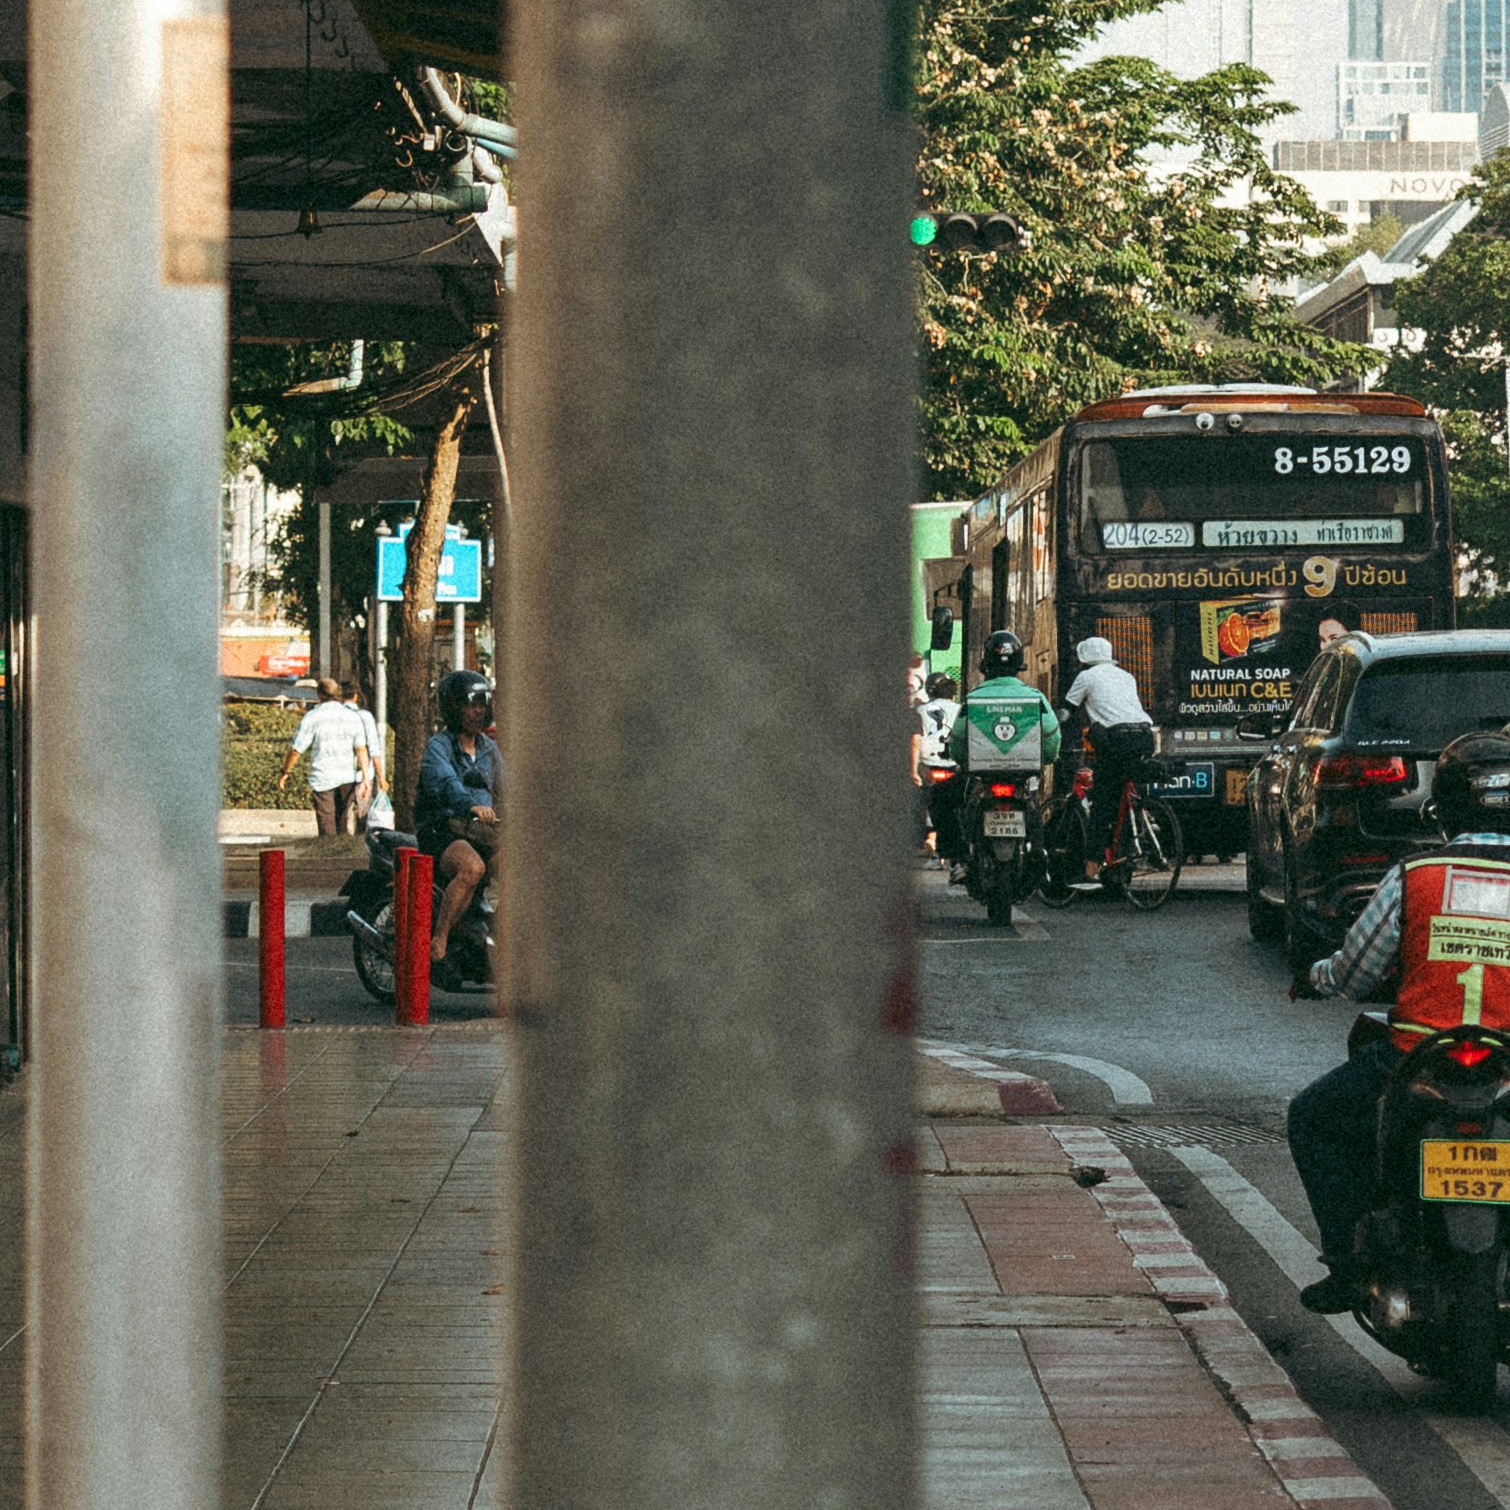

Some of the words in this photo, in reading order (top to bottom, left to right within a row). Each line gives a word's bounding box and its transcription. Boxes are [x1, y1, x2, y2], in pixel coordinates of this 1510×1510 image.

[1274, 446, 1411, 474] 8-55129
[1217, 521, 1298, 545] ห้วยขวาง
[1107, 561, 1297, 589] ยอดขายอันดับหนึ่ง
[1303, 556, 1339, 597] 9
[1344, 564, 1407, 586] ปีซ้อน
[1190, 669, 1251, 681] NATURAL
[1255, 668, 1291, 680] SOAP
[1250, 681, 1292, 698] C&E
[1440, 1179, 1504, 1198] 1537
